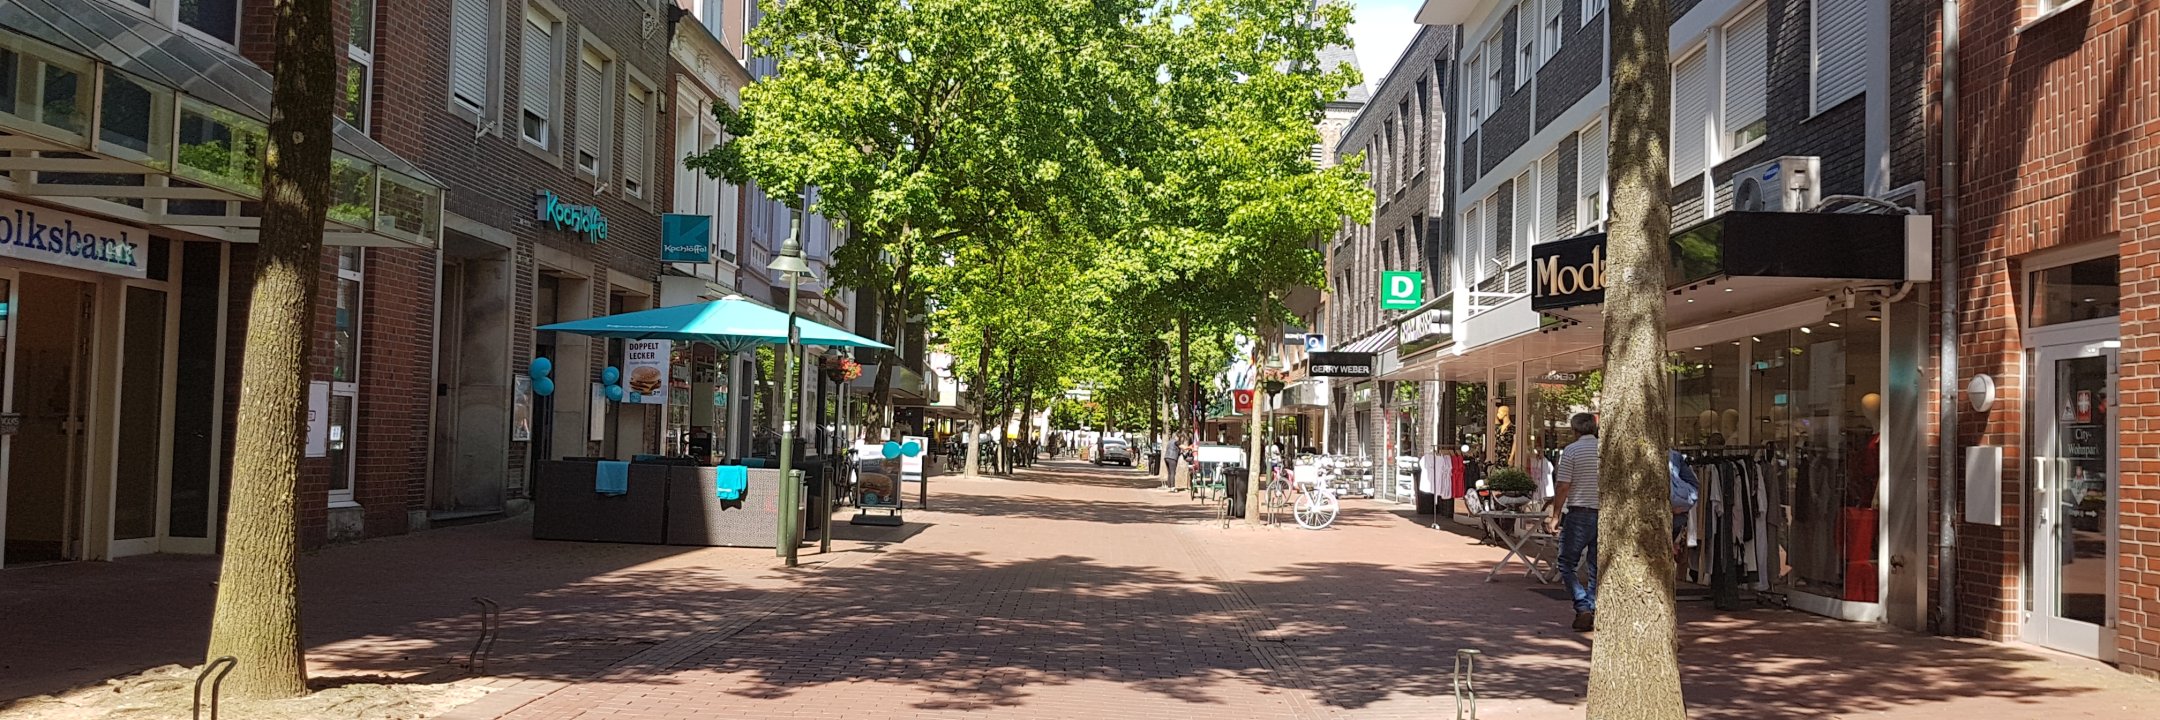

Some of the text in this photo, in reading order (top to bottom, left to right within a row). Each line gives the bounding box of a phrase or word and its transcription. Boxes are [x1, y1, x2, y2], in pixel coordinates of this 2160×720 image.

[545, 189, 608, 245] Kochlöffel
[664, 244, 707, 254] Kochlöffel
[1391, 275, 1414, 298] D
[629, 342, 659, 350] DOPPELT
[629, 352, 655, 360] LECKER
[1311, 365, 1370, 374] GERRY WEBER
